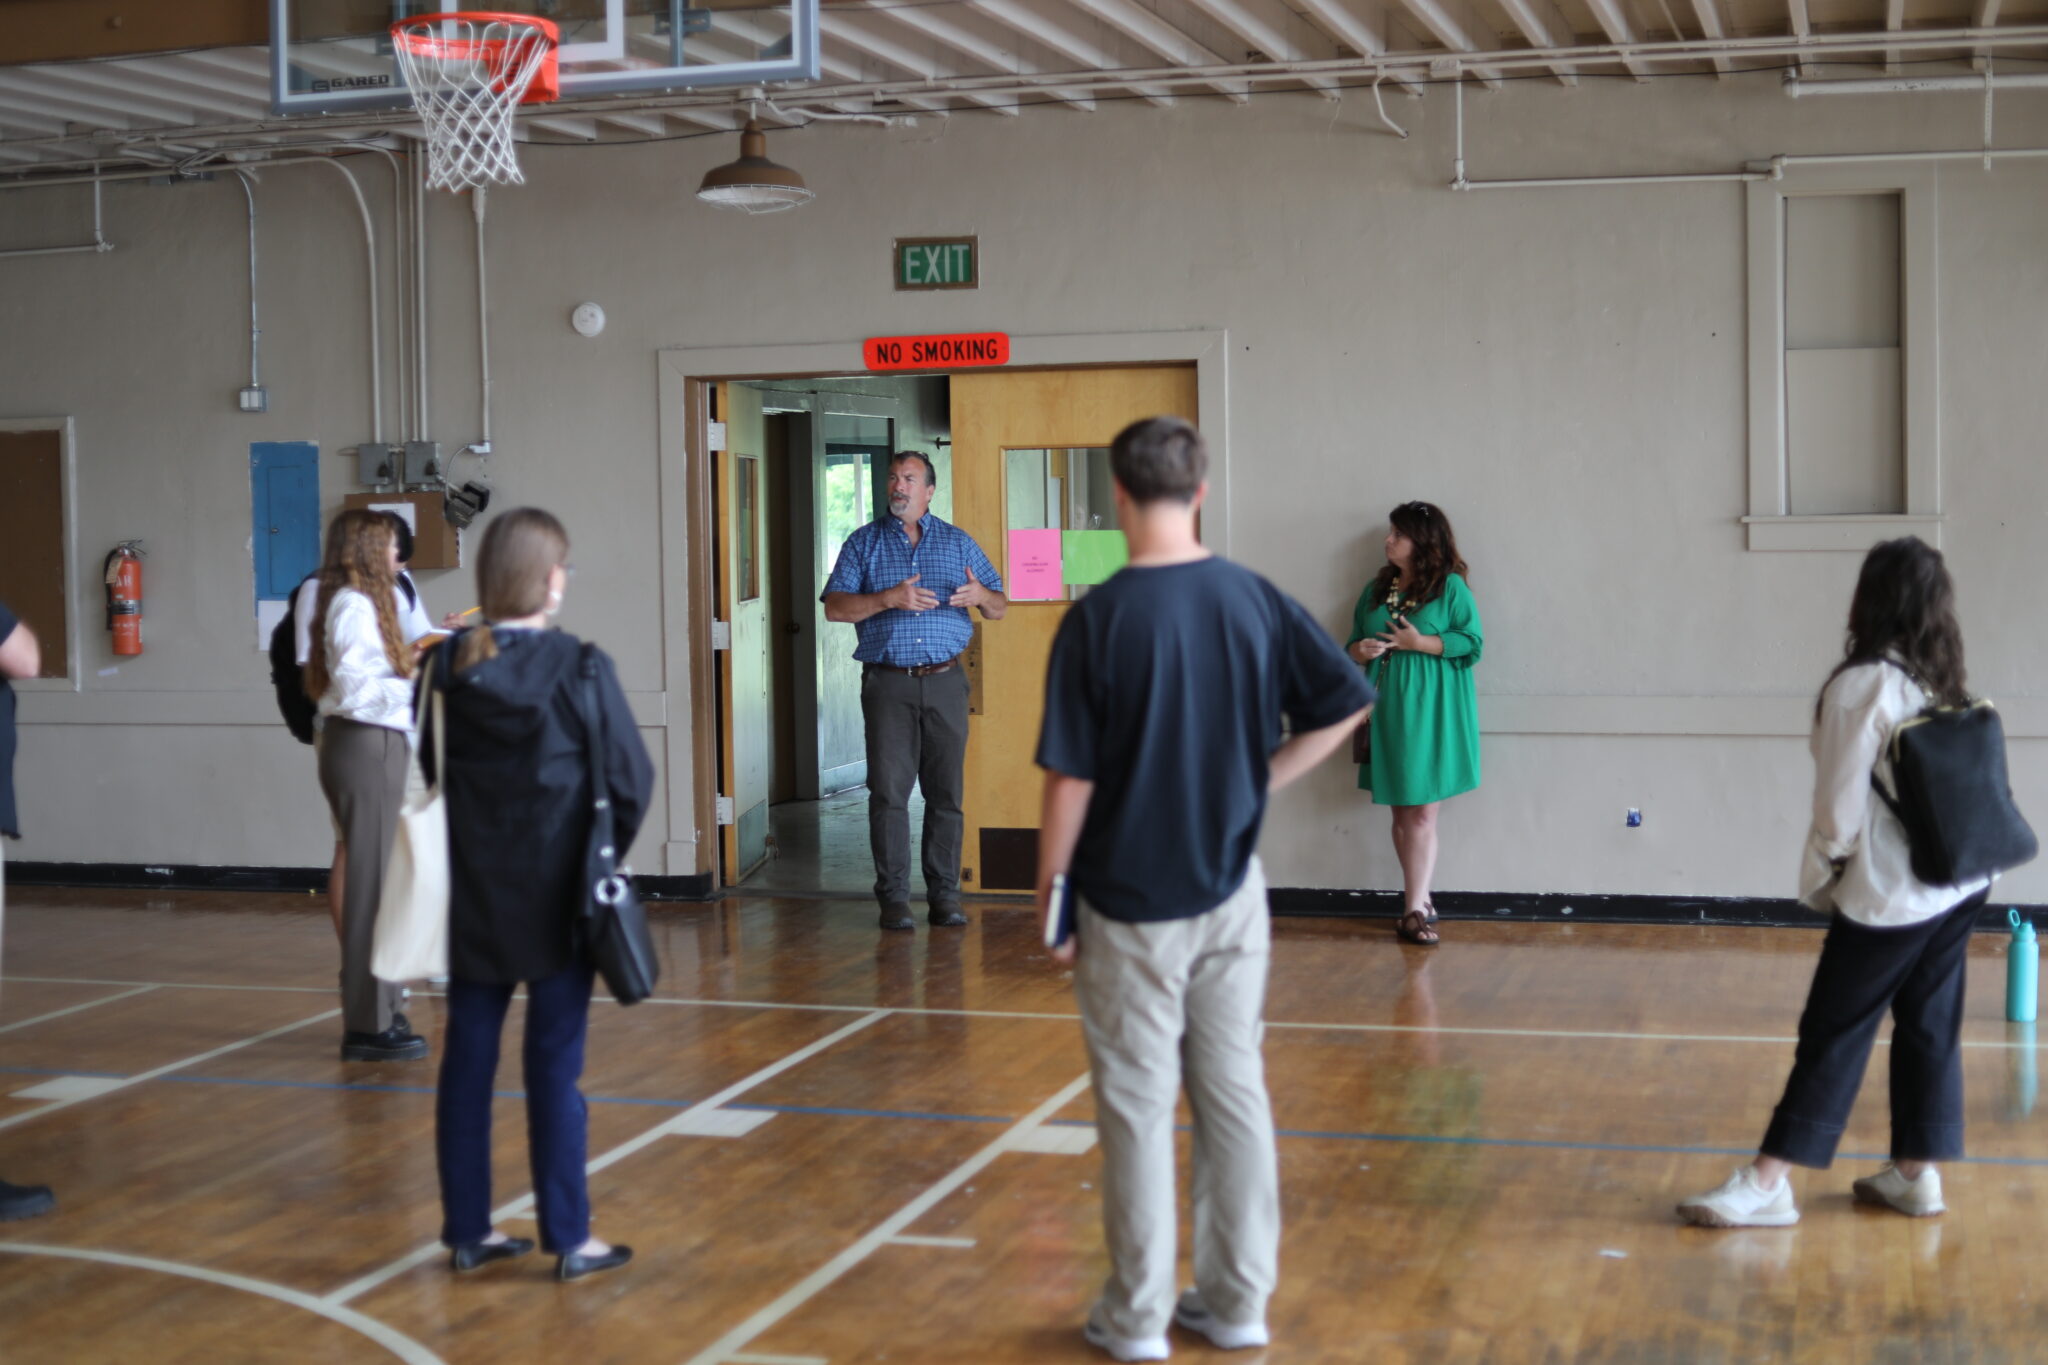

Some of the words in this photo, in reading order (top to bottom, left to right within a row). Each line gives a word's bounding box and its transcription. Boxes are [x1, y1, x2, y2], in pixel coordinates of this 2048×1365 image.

[331, 74, 389, 88] GARED
[905, 244, 969, 284] EXIT
[877, 343, 902, 364] NO
[912, 338, 998, 363] SMOKING
